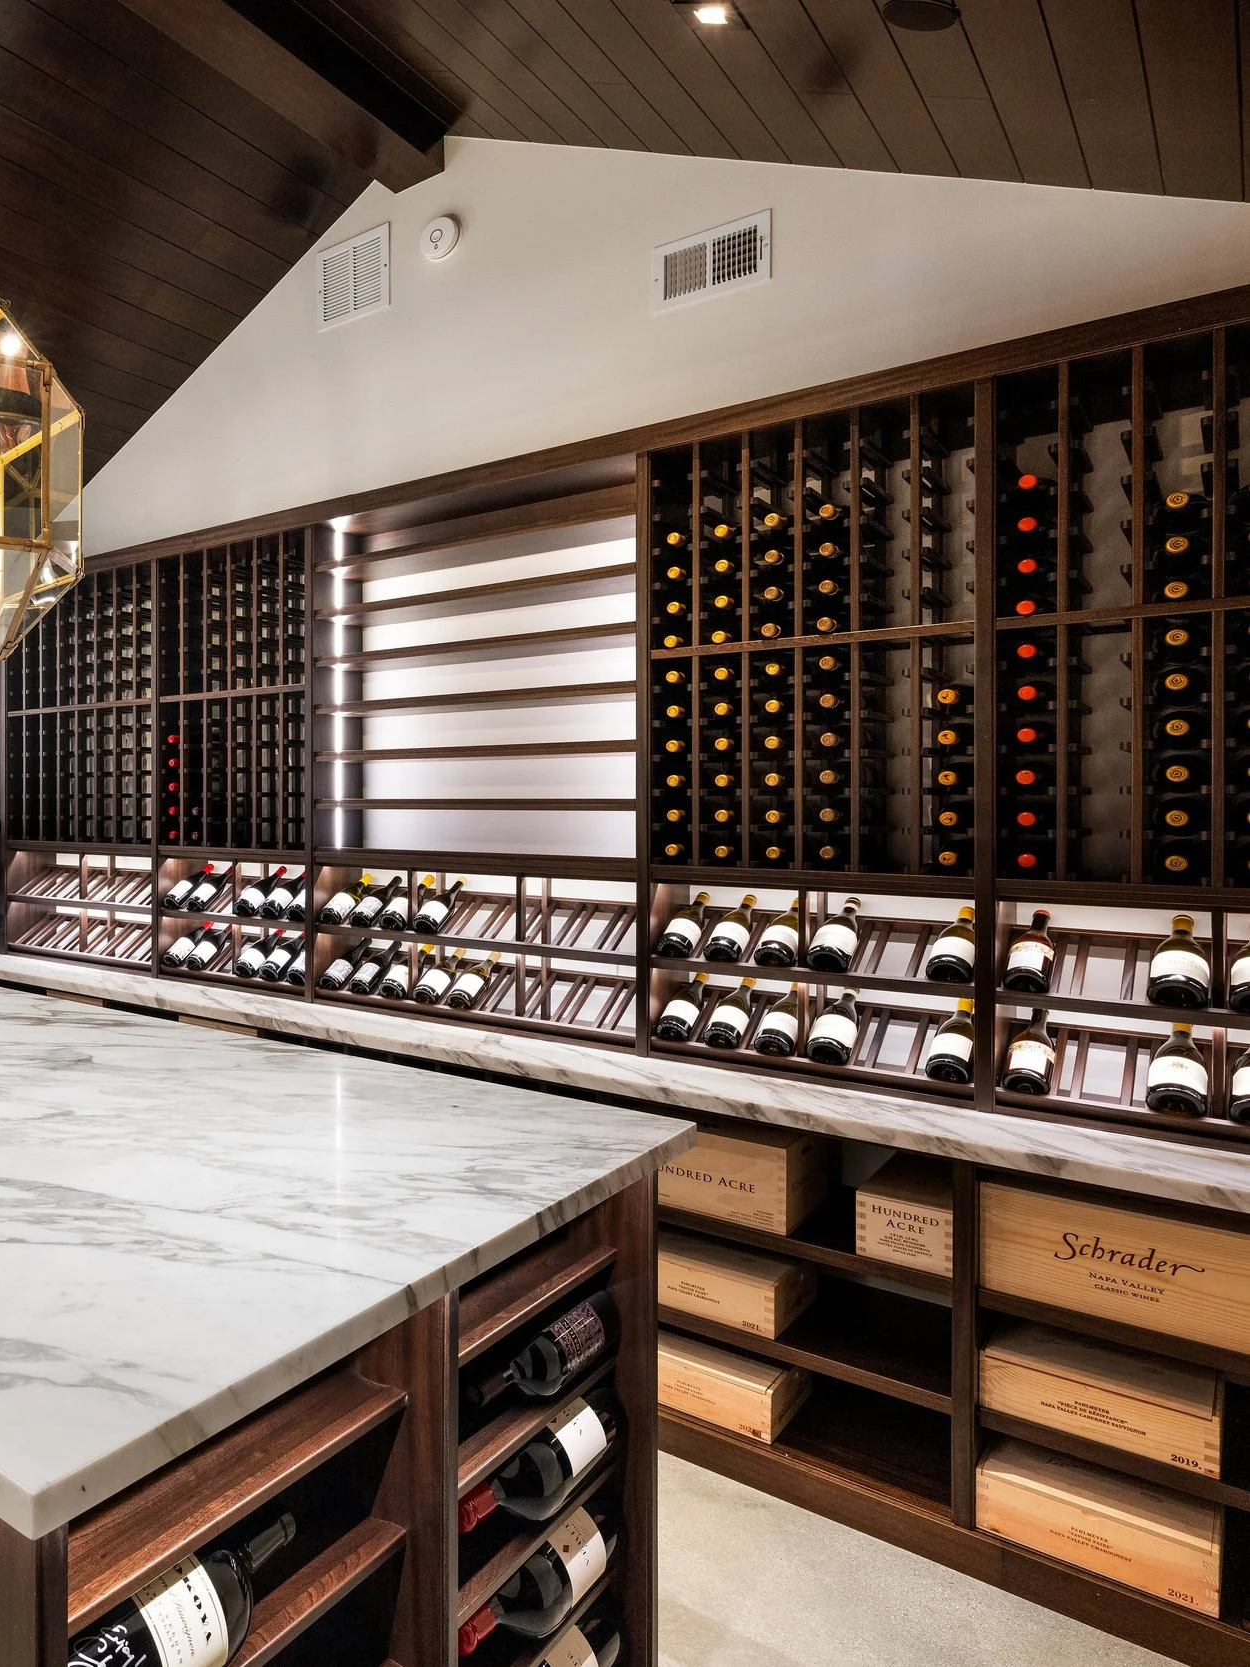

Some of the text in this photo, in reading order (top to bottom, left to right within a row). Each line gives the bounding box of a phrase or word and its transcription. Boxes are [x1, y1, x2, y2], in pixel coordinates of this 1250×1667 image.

[718, 1176, 756, 1194] ACRE
[872, 1204, 940, 1227] HUNDRED
[886, 1219, 926, 1235] ACRE
[1054, 1232, 1206, 1276] Schrader
[1088, 1271, 1166, 1296] NAPA VALLEY
[1094, 1284, 1160, 1303] CLASSIC WINES
[1074, 1400, 1110, 1415] PAHLMEYER
[1040, 1401, 1148, 1436] NAPA VALLEY CABERNET SAUVIGNON
[1170, 1454, 1202, 1470] 2019.
[1070, 1526, 1109, 1543] PAHLMEYER
[1050, 1529, 1132, 1563] NAPA VALLEY CHARDONNAY
[173, 1563, 211, 1646] OKOYA
[1168, 1588, 1199, 1606] 2021.
